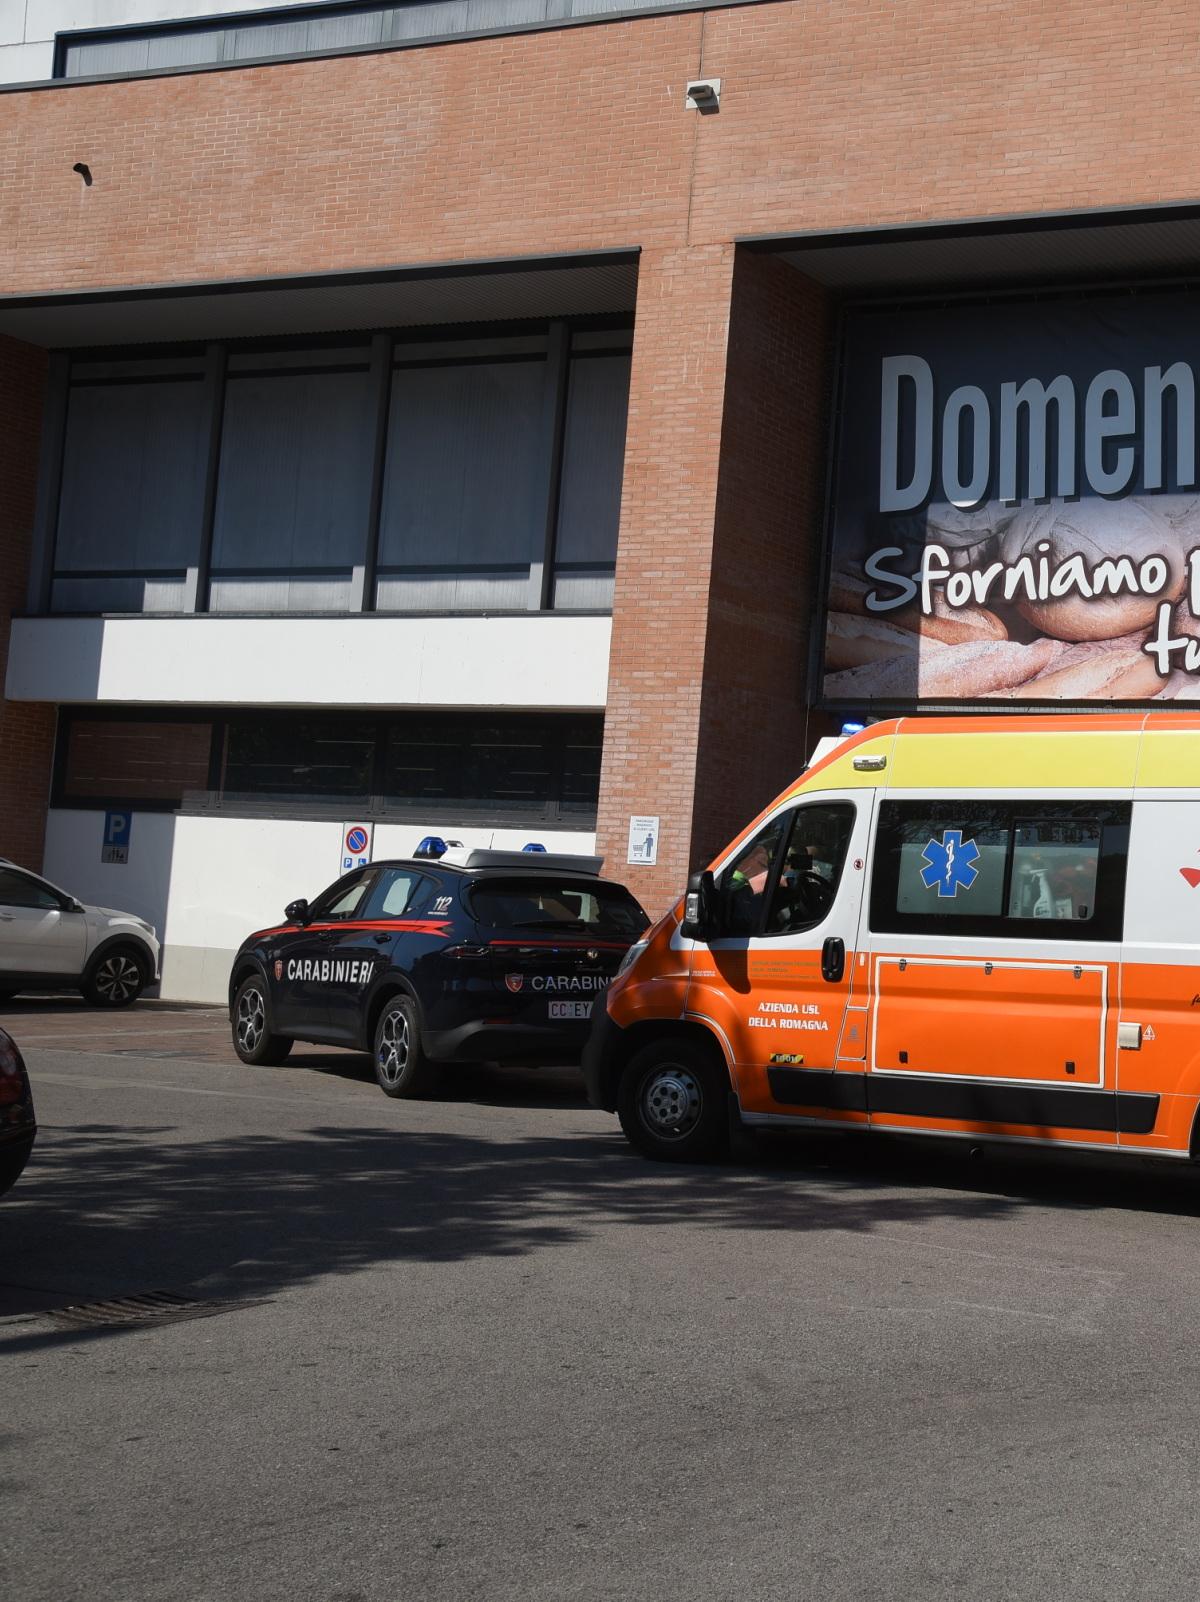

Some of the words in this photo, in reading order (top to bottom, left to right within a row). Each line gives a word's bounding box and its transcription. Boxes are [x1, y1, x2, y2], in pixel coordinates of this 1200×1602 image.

[864, 543, 1167, 615] Sforniamo
[433, 896, 453, 911] 112
[287, 959, 375, 984] CARABINIERI
[531, 975, 614, 990] CARABIN
[758, 1002, 799, 1014] AZIENDA
[801, 1004, 820, 1015] USL
[748, 1016, 777, 1028] DELLA
[779, 1018, 829, 1031] ROMAGNA
